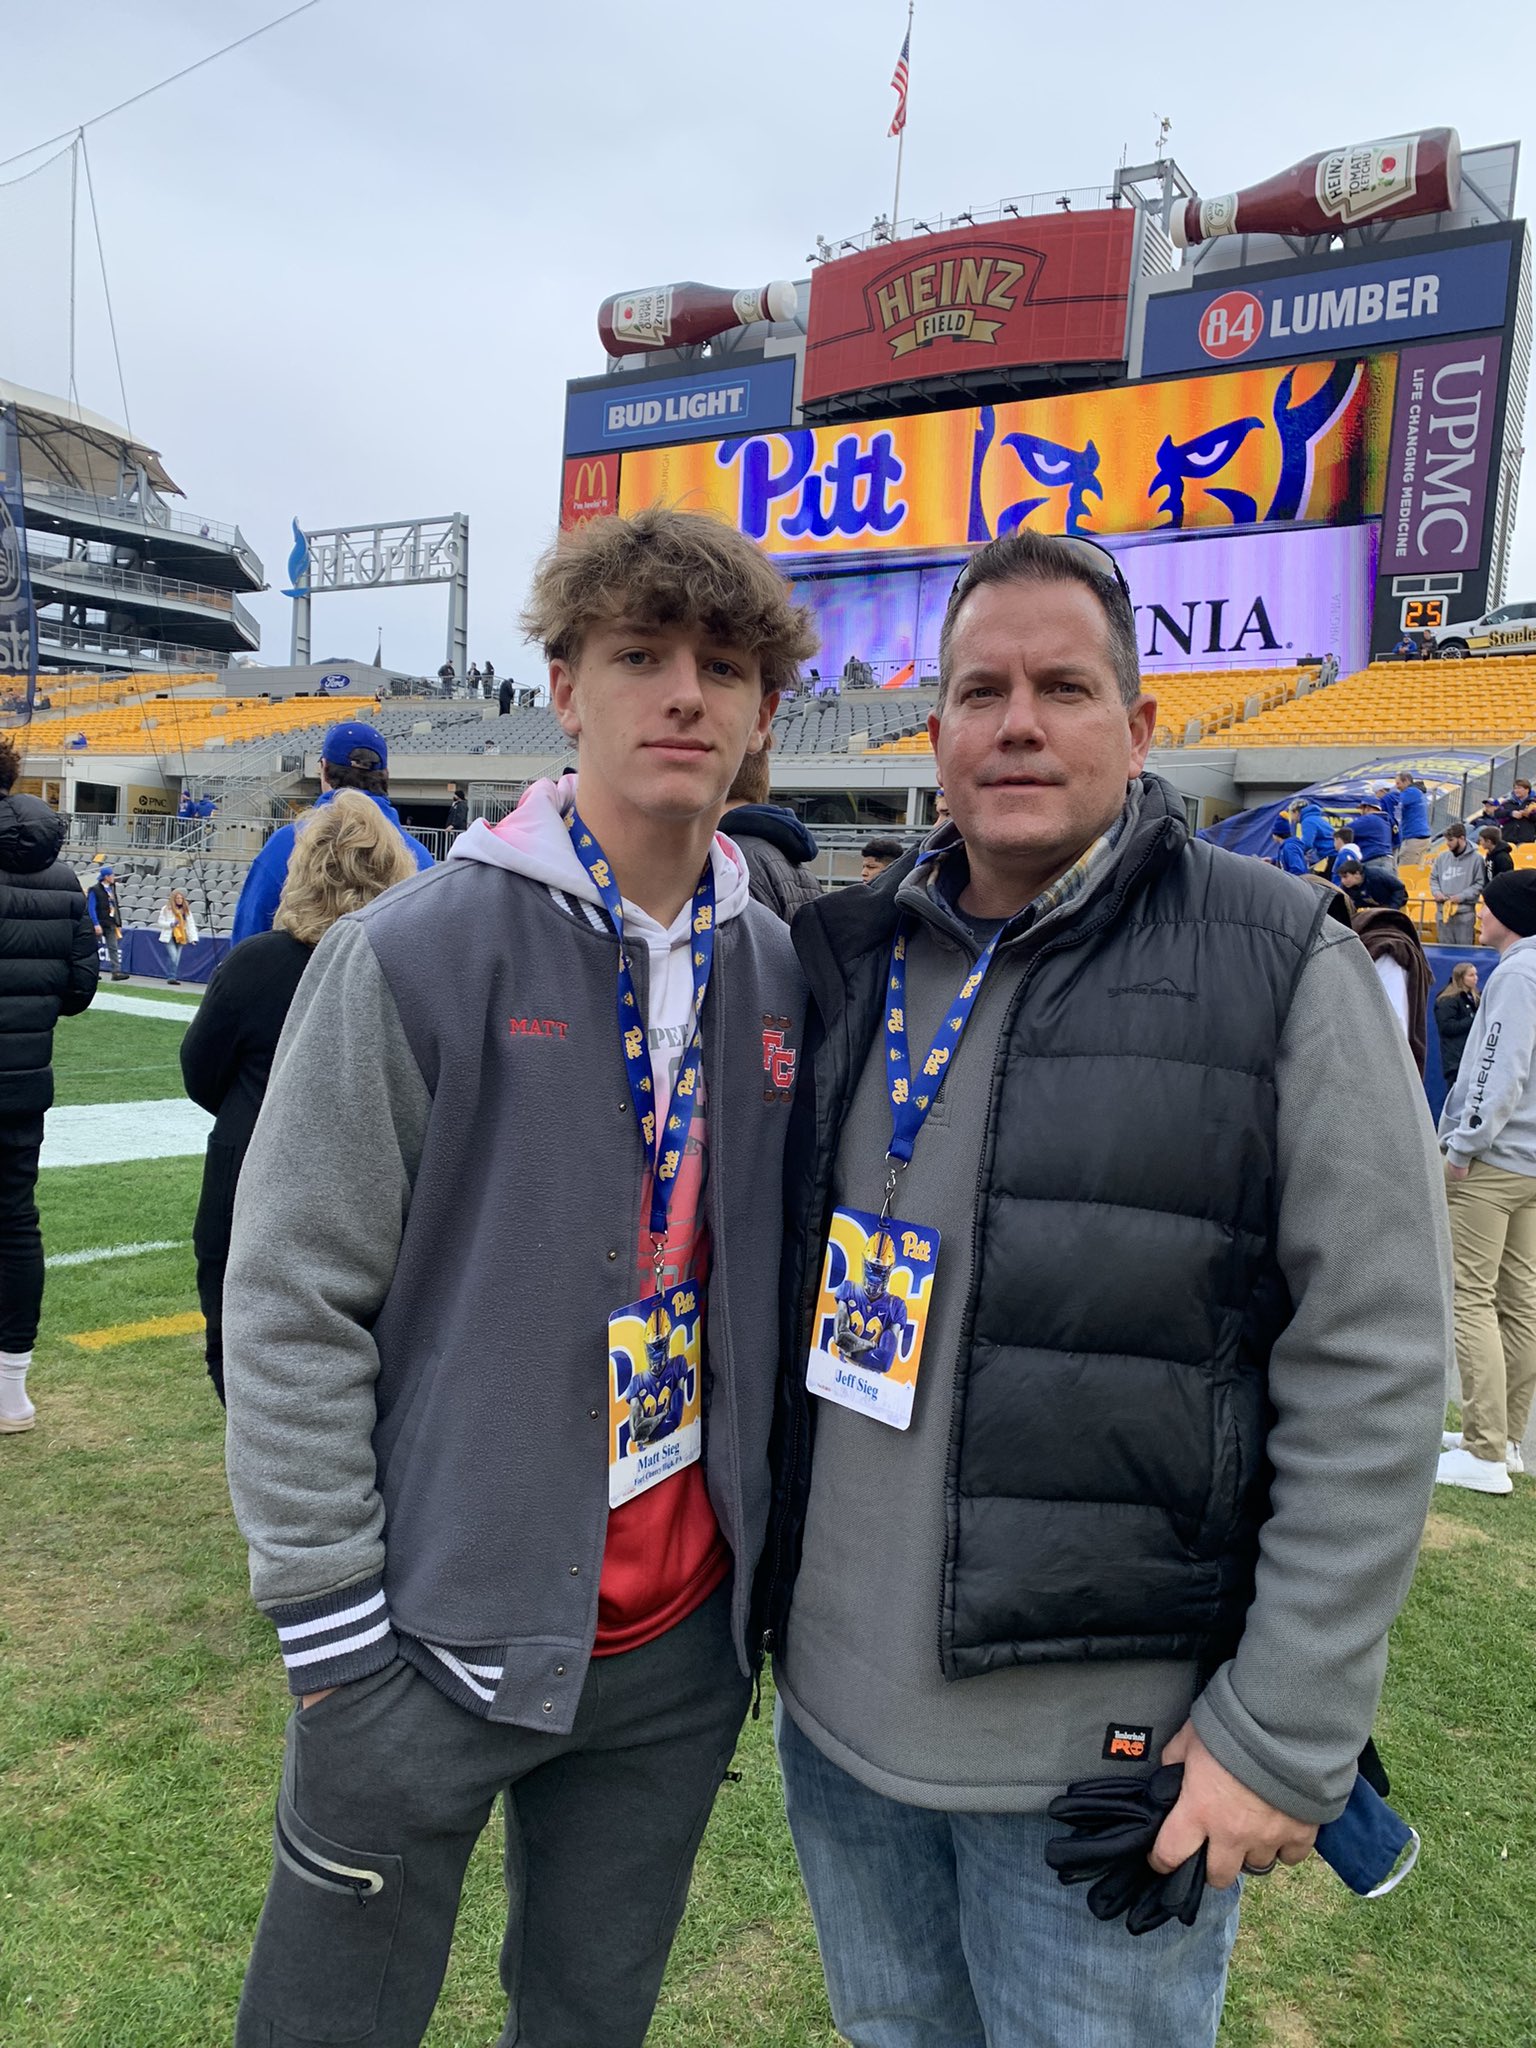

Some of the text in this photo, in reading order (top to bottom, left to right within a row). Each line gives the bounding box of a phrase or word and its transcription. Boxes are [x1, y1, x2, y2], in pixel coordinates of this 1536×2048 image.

[1349, 153, 1362, 198] TOMAT
[1361, 153, 1372, 192] KETCHU
[877, 256, 1025, 333] HEINZ
[644, 296, 653, 329] OMATO
[923, 314, 966, 337] FIELD
[1206, 274, 1440, 347] 84 LUMBER
[608, 387, 743, 430] BUD LIGHT
[1395, 368, 1425, 558] LIFE CHANGING MEDICINE
[1416, 354, 1486, 557] UPMC
[715, 428, 909, 540] Pitt
[318, 540, 460, 588] PEOPLES
[1406, 601, 1441, 628] 25
[324, 676, 346, 688] Ford
[149, 797, 167, 808] PNC
[589, 858, 611, 888] Pitt
[694, 905, 713, 934] Pitt
[509, 1018, 569, 1040] MATT
[887, 1007, 904, 1034] Pitt
[624, 1025, 643, 1060] Pitt
[923, 1046, 949, 1075] Pitt
[1471, 1021, 1502, 1113] carhartt
[677, 1067, 696, 1097] Pitt
[892, 1077, 909, 1104] Pitt
[641, 1110, 655, 1145] Pitt
[659, 1150, 680, 1181] Pitt
[901, 1230, 931, 1262] Pitt
[672, 1290, 695, 1317] Pitt
[835, 1370, 879, 1401] Jeff Sieg
[638, 1452, 660, 1472] Matt
[661, 1443, 680, 1460] Sieg
